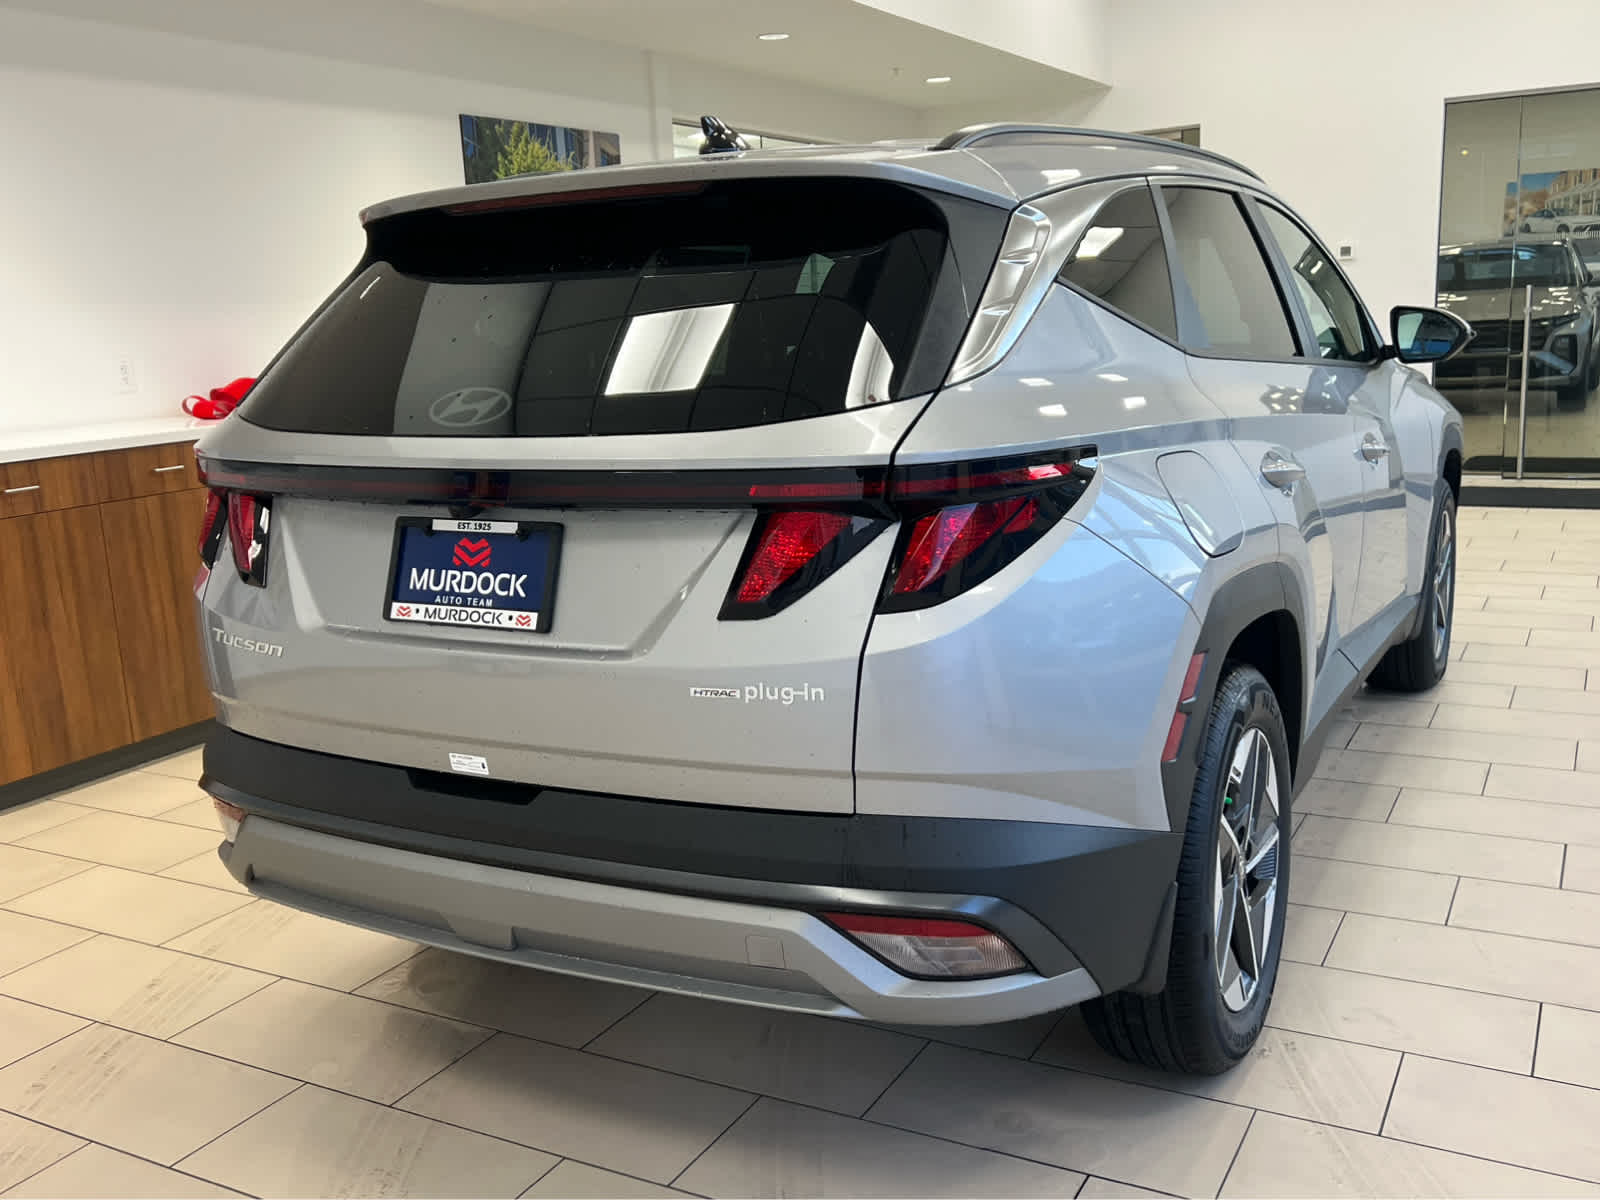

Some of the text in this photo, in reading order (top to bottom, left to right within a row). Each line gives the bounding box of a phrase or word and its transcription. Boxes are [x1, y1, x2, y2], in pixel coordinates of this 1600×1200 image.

[457, 521, 492, 531] EST. 1925
[409, 567, 528, 598] MURDOCK
[434, 595, 493, 607] AUTO TEAM
[423, 606, 503, 625] MURDOCK
[693, 681, 825, 705] HTRAC plug-in
